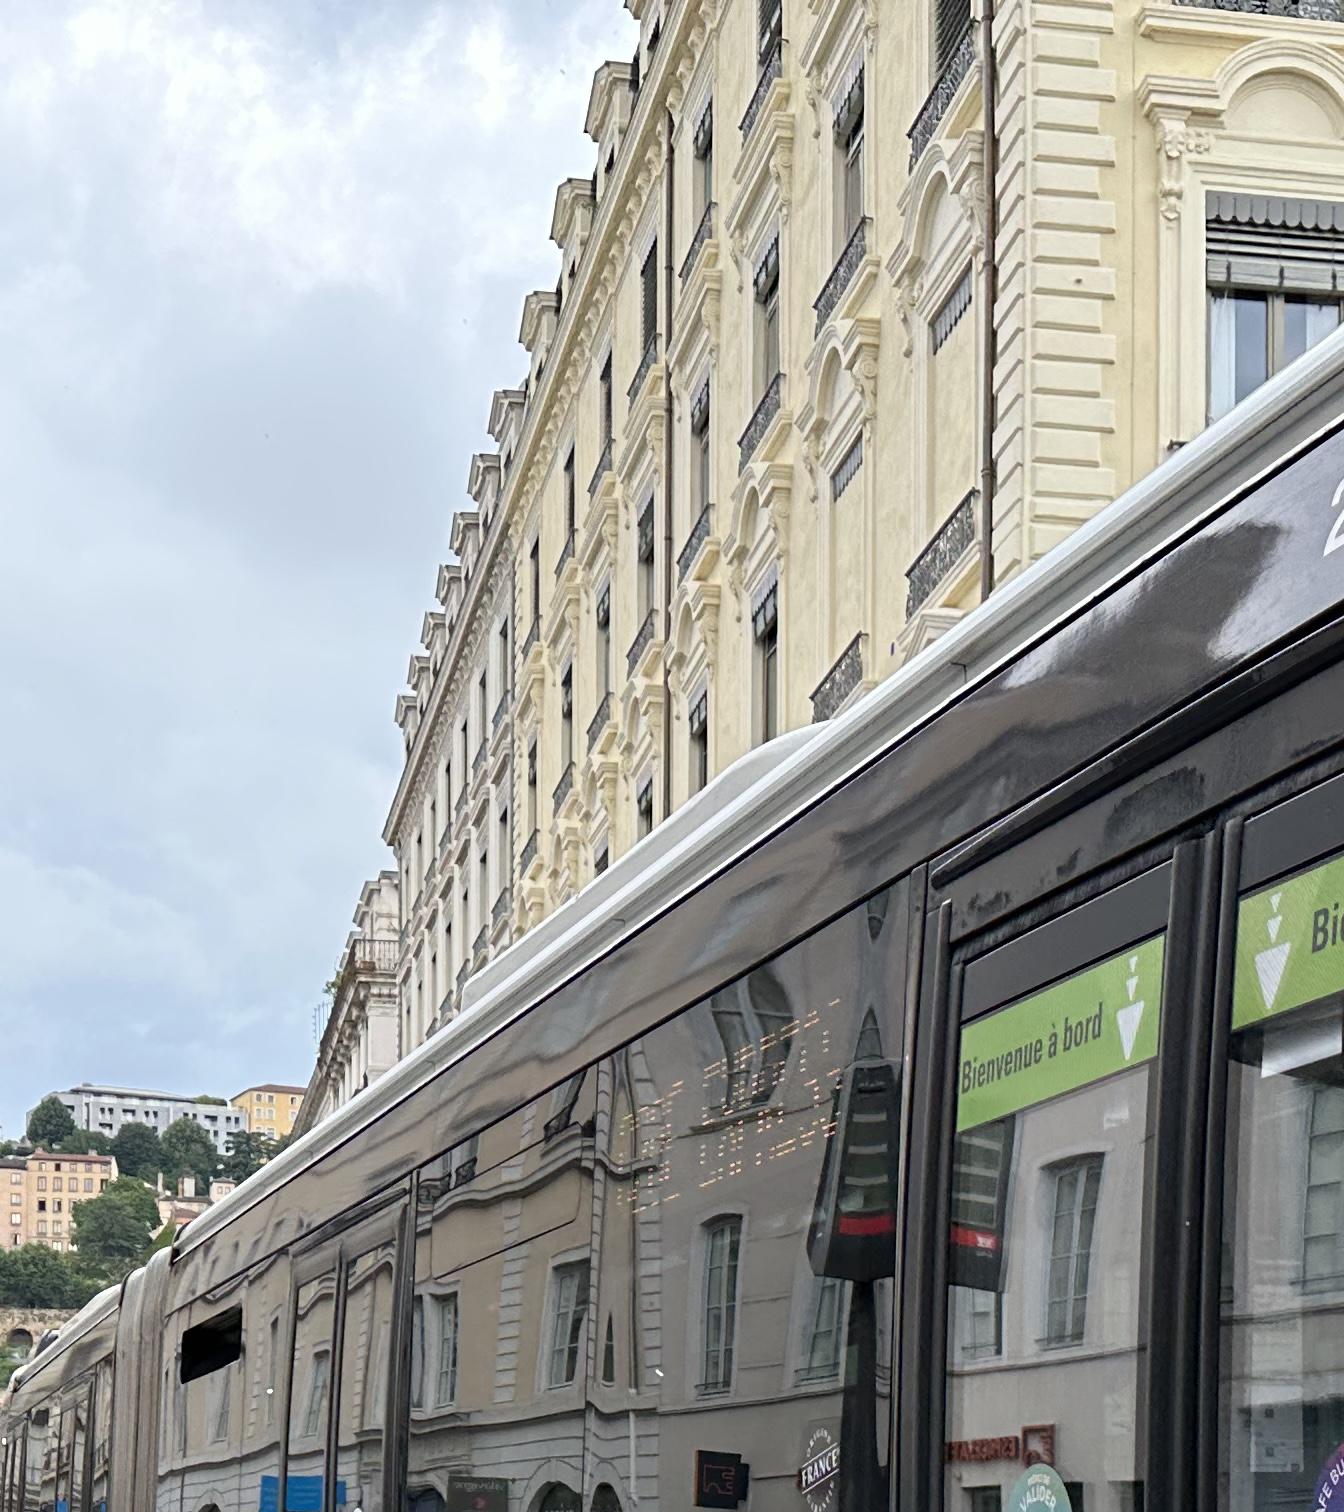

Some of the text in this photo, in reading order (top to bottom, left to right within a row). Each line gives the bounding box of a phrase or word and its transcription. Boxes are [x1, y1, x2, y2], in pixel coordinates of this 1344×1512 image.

[961, 1001, 1104, 1095] Bienvenue à bord
[801, 1447, 838, 1488] FRANCE
[1019, 1485, 1057, 1512] VALIDER
